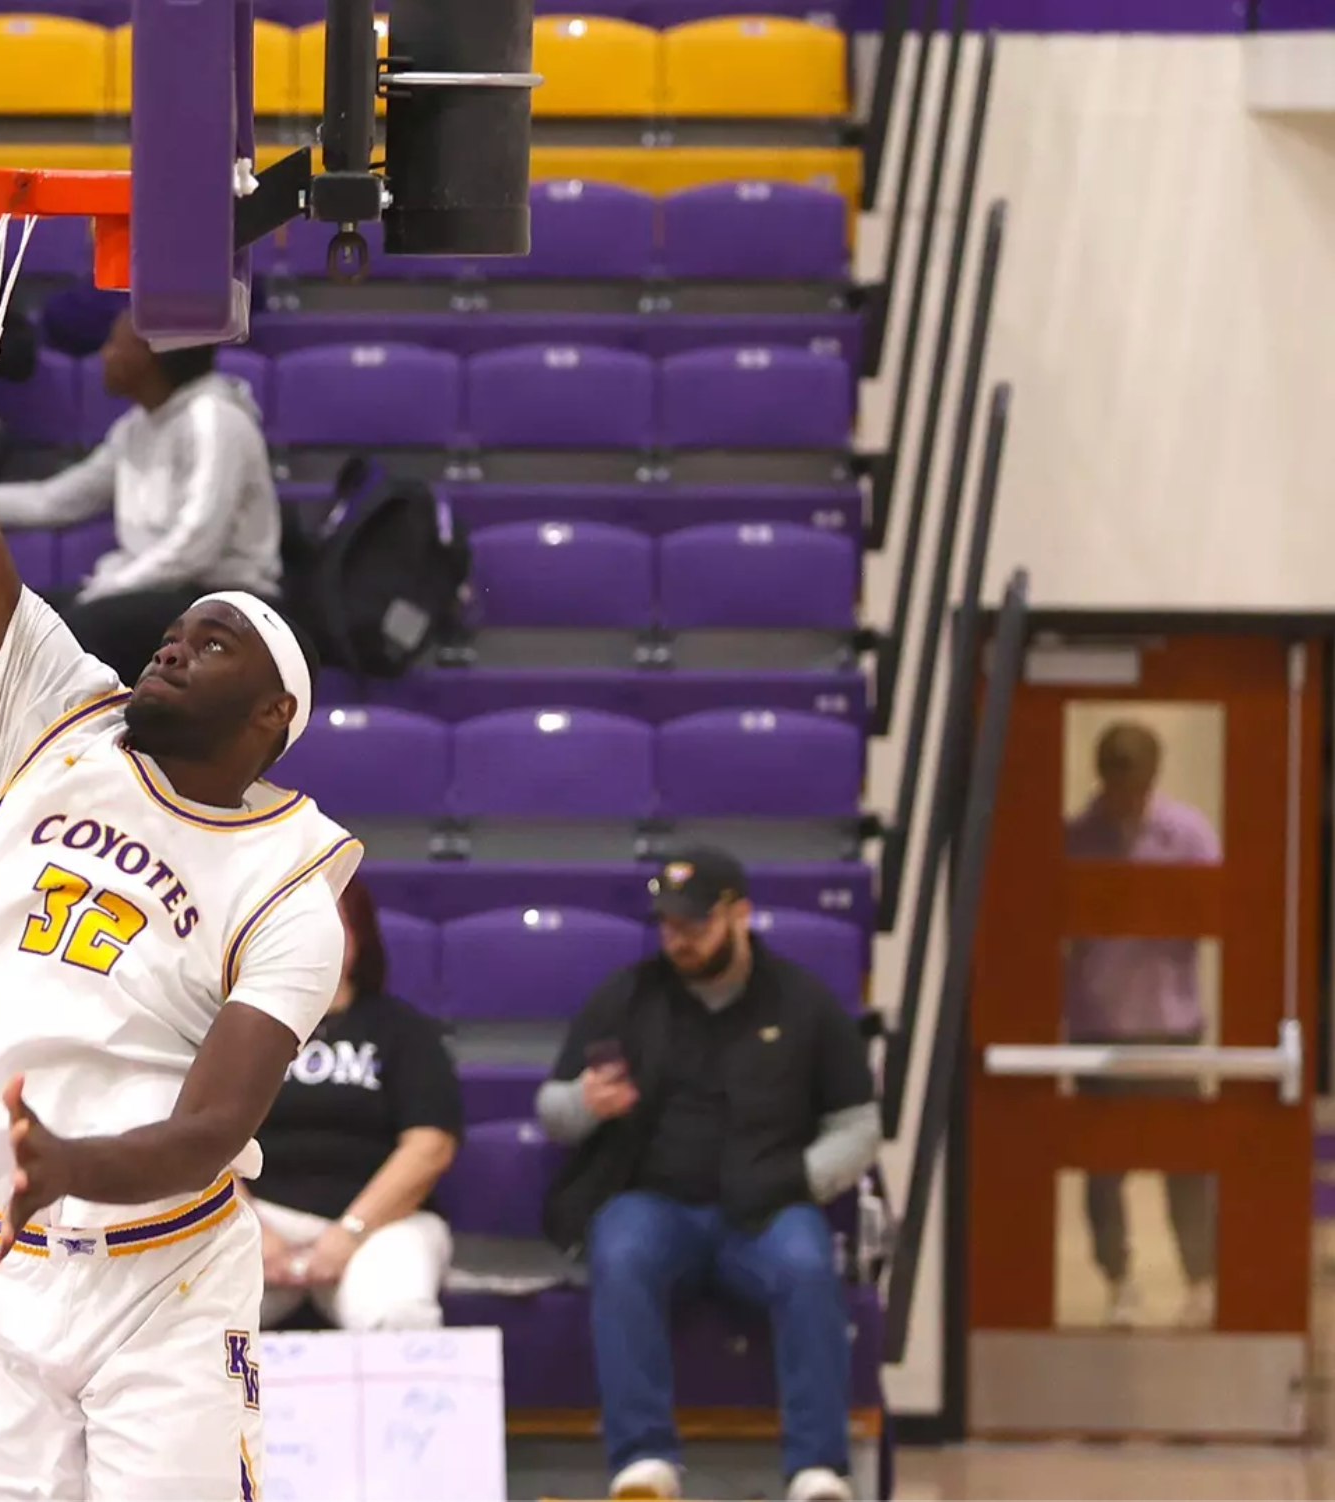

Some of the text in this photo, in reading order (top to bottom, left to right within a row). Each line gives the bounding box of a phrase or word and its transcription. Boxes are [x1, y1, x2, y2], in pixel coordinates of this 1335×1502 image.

[18, 862, 149, 976] 32
[31, 814, 200, 938] COYOTES
[283, 1039, 382, 1091] OM
